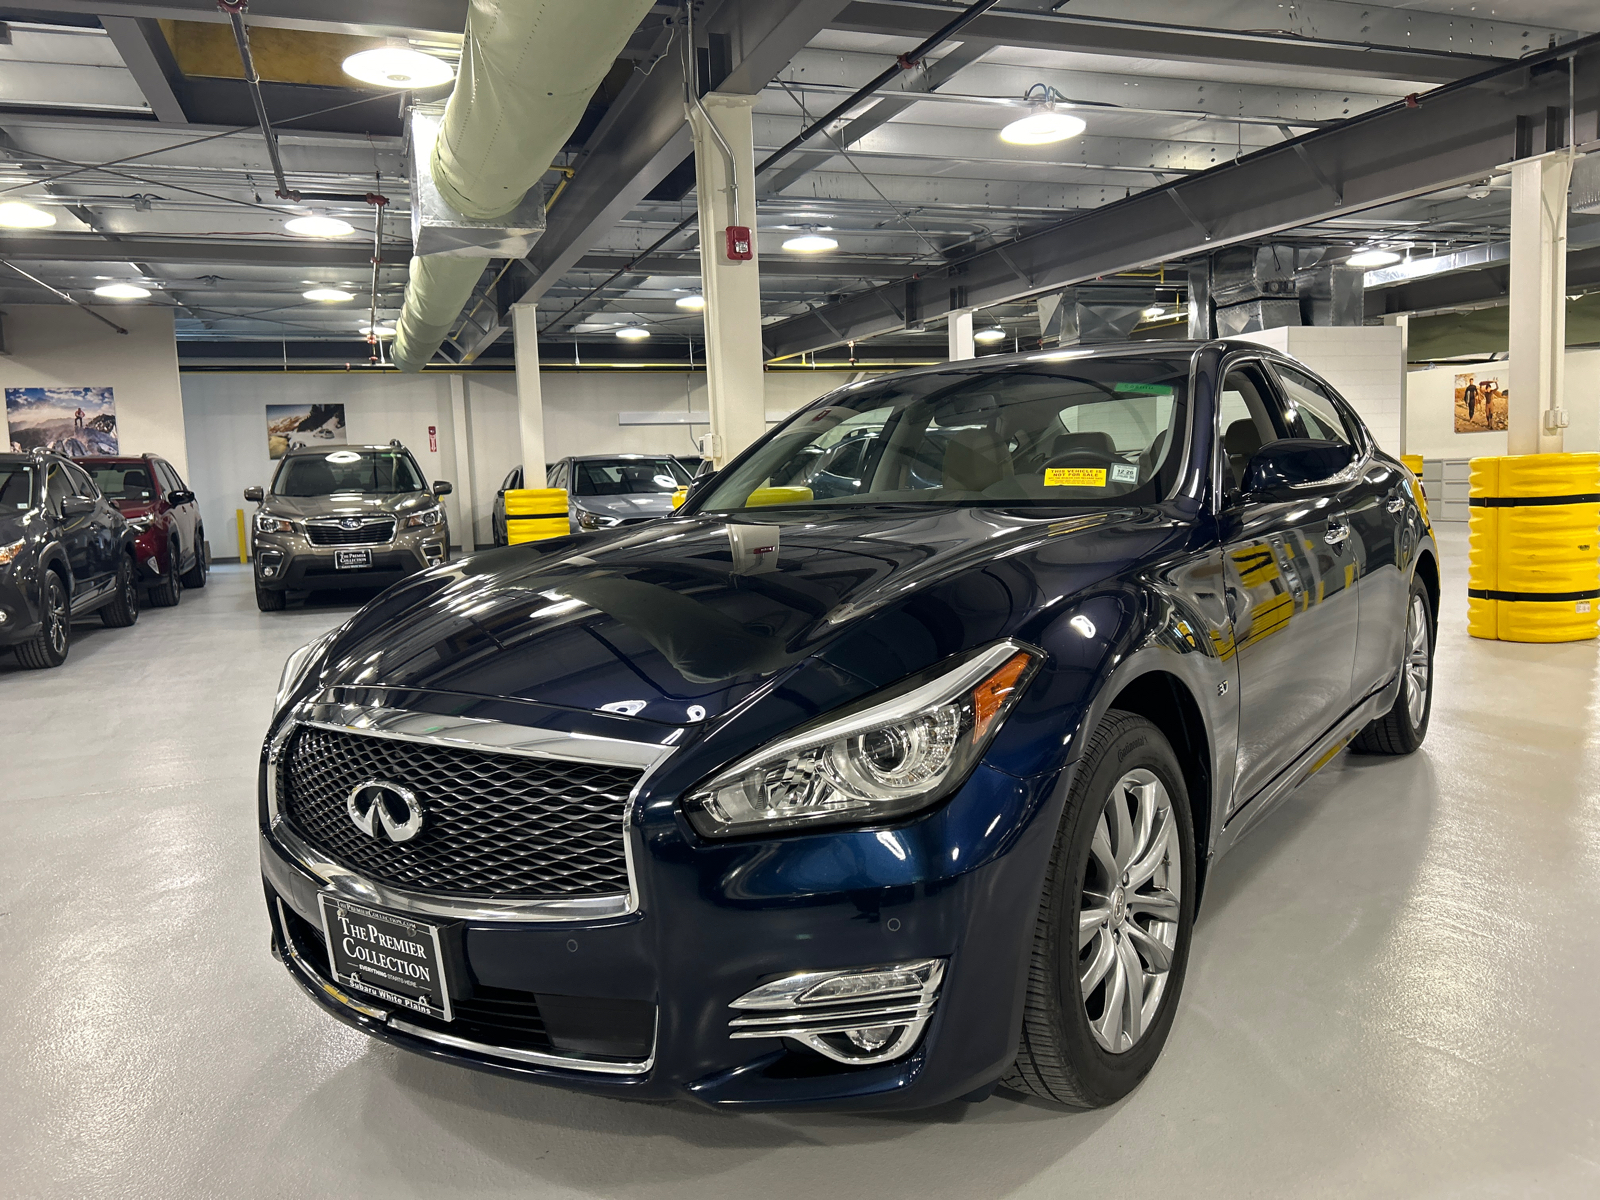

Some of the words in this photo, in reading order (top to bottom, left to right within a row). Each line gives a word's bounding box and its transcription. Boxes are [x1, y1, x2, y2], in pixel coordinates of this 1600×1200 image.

[1117, 735, 1144, 763] Continental
[337, 917, 369, 941] THE
[367, 924, 427, 959] PREMIER
[342, 937, 431, 982] COLLECTION
[359, 964, 388, 979] EVERYTHING
[349, 979, 377, 995] Subaru
[378, 989, 402, 1004] White
[404, 999, 431, 1014] Plains
